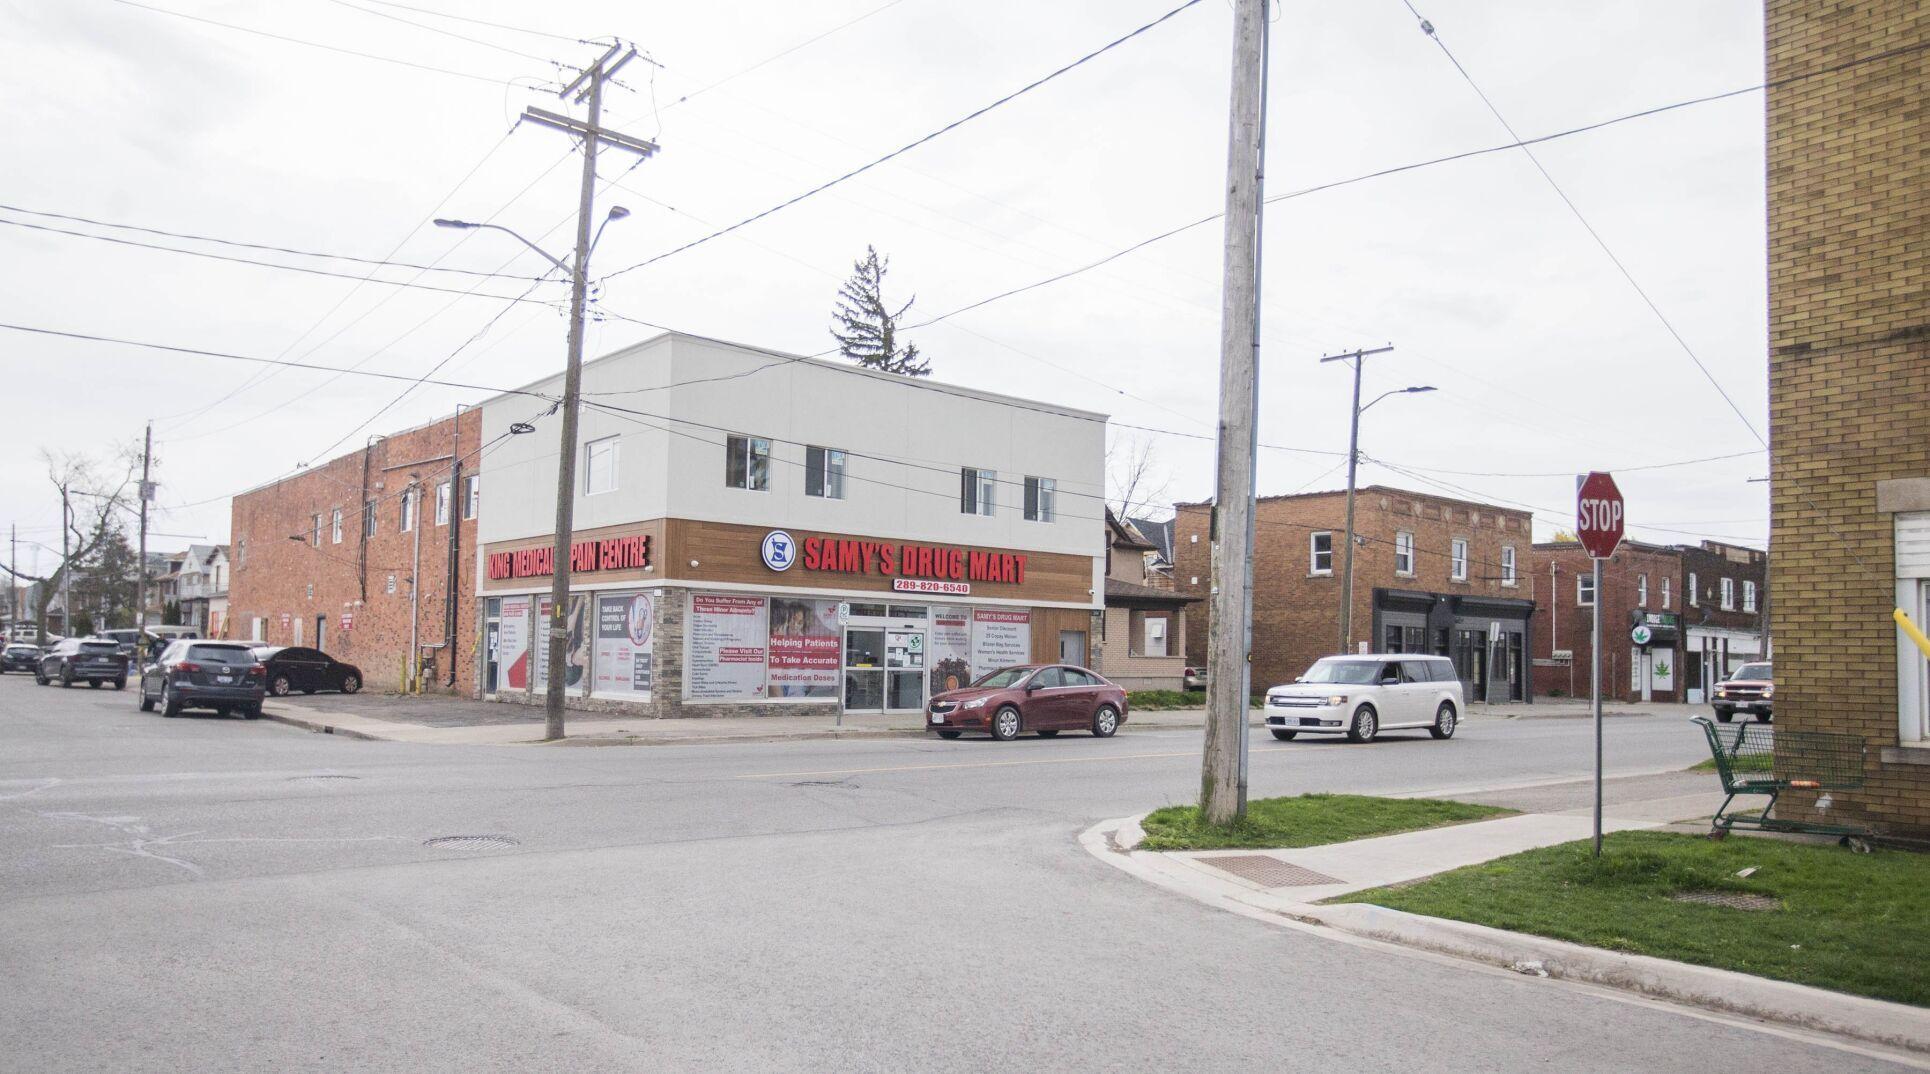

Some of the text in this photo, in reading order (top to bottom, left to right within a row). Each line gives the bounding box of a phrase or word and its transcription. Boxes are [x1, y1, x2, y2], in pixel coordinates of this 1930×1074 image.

[1580, 499, 1622, 532] STOP
[488, 535, 646, 580] KING MEDICAL PAIN CENTRE
[804, 536, 1028, 583] SAMY'S DRUG MART
[896, 580, 969, 593] 289-820-6540
[770, 638, 839, 648] Helping Patients
[770, 656, 838, 665] To Take Accurate
[813, 674, 835, 682] Doses
